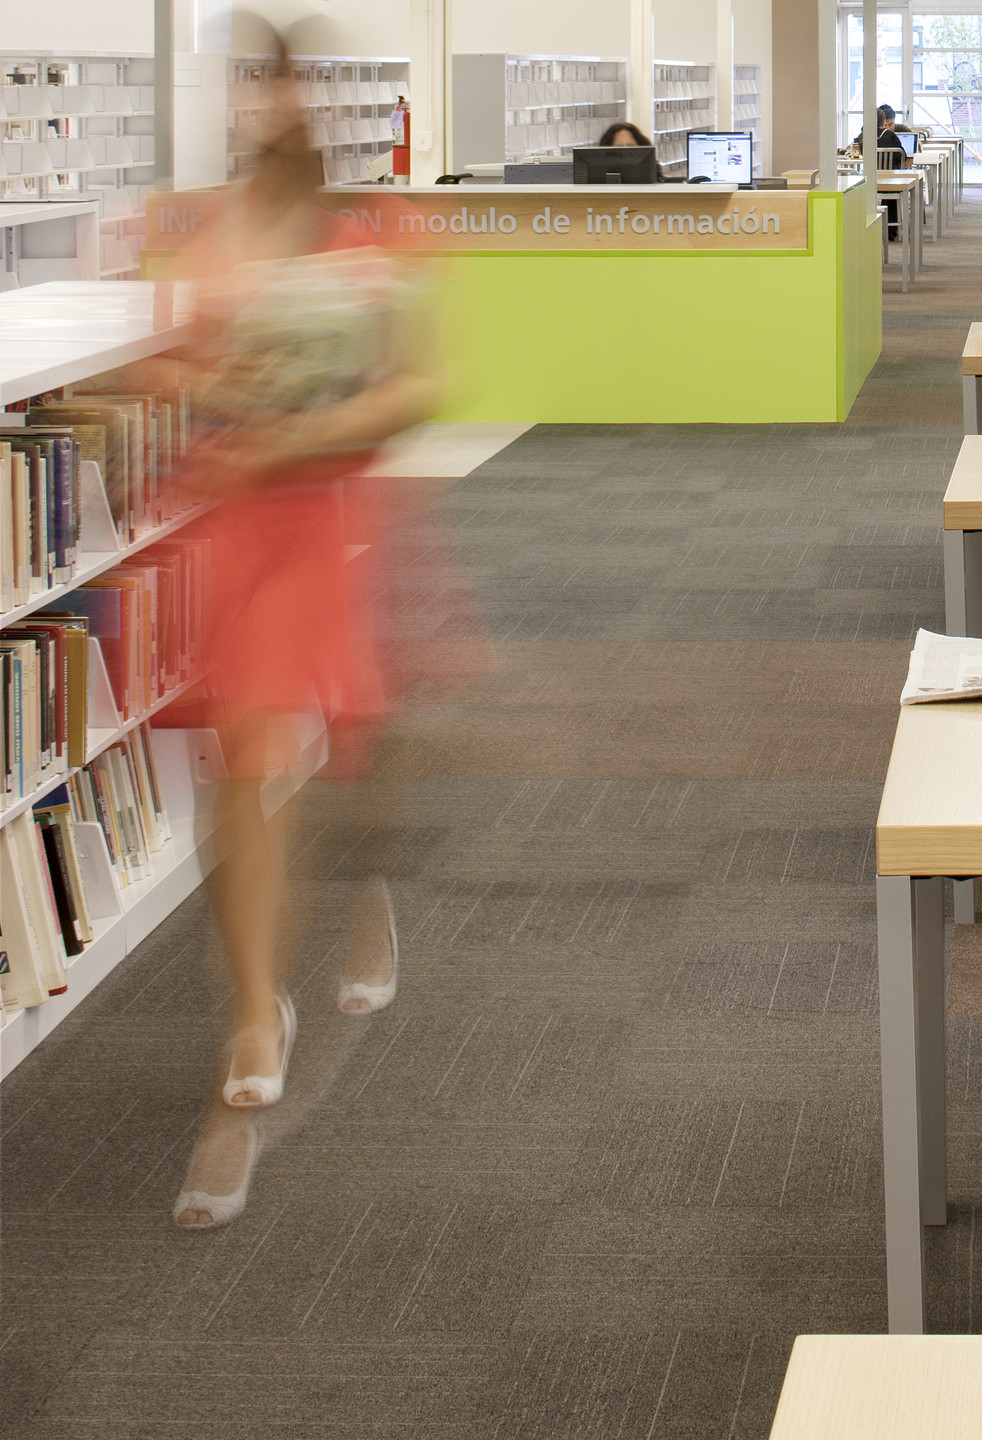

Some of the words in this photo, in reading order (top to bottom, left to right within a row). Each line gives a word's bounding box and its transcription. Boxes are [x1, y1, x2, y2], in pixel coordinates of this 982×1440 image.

[399, 207, 517, 234] modulo
[532, 207, 571, 234] de
[586, 206, 780, 234] información
